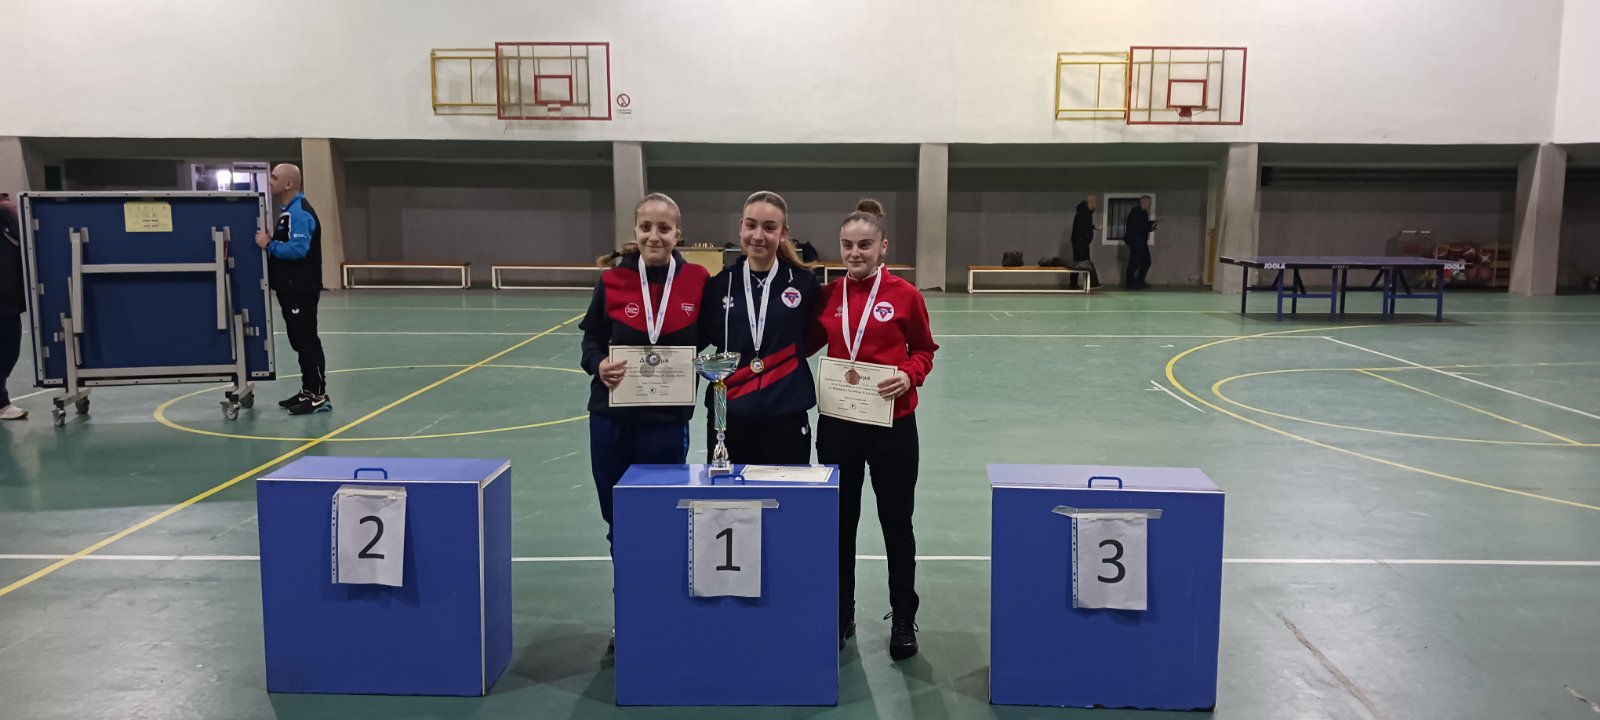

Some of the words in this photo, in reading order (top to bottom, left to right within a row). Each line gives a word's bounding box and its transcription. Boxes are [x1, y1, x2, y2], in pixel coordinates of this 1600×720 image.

[357, 515, 385, 560] 2
[715, 527, 741, 572] 1
[1097, 539, 1126, 584] 3
